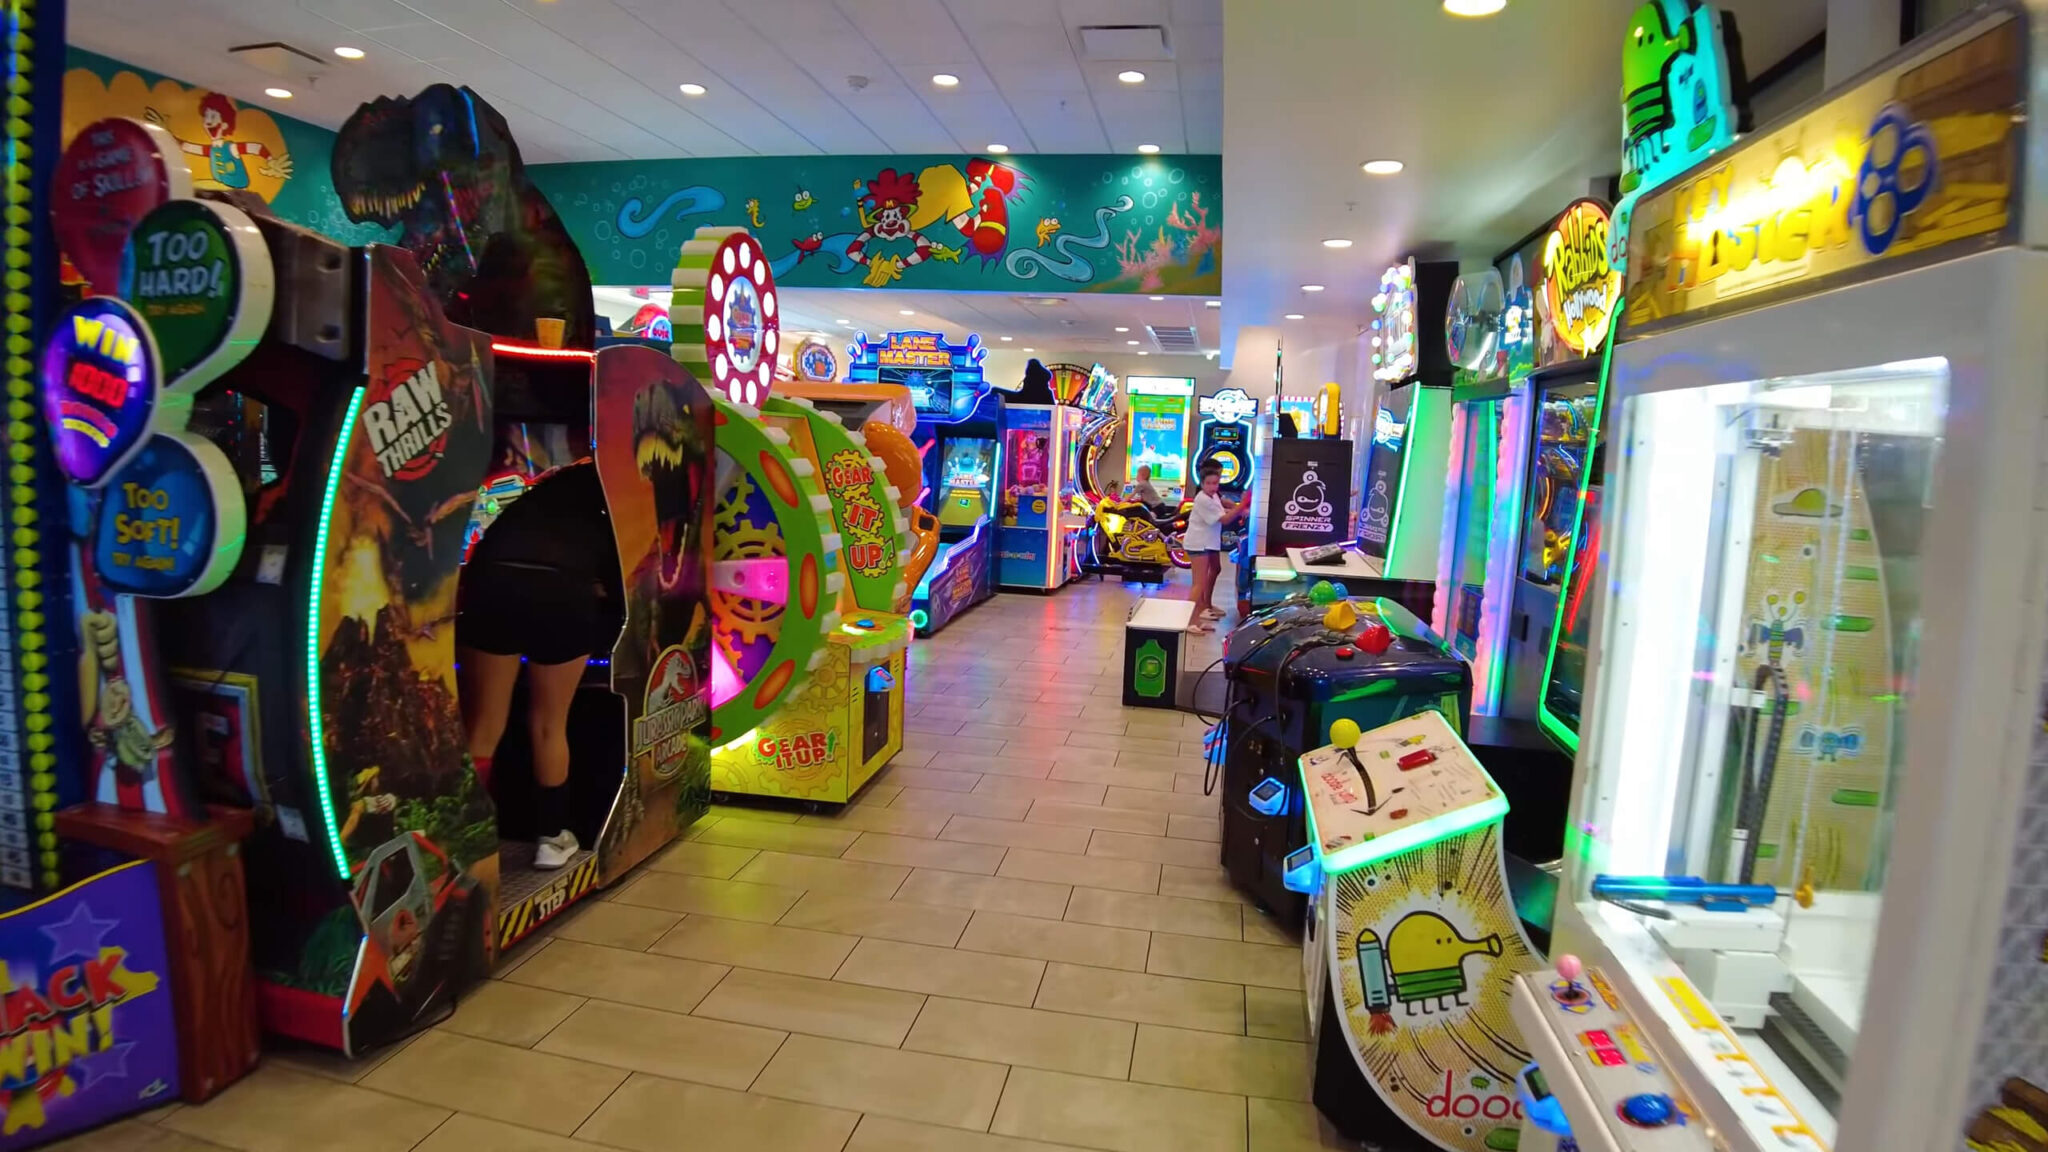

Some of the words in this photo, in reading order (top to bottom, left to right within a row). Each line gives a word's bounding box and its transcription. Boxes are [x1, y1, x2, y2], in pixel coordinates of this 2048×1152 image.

[147, 231, 208, 266] TOO
[139, 259, 223, 299] HARD!
[73, 315, 139, 364] WIN
[890, 335, 938, 350] LANE
[879, 350, 951, 366] MASTER
[362, 360, 442, 455] RAW
[376, 402, 453, 478] THRILLS
[832, 466, 874, 489] GEAR
[123, 483, 169, 511] TOO
[115, 513, 181, 551] SOFT!
[848, 503, 879, 532] IT
[1284, 522, 1330, 531] FRENZY
[1285, 515, 1332, 523] SPINNER
[850, 539, 895, 570] UP!
[757, 732, 828, 758] GEAR
[775, 752, 794, 770] IT
[539, 886, 567, 920] STEP
[0, 953, 127, 1036] ACK
